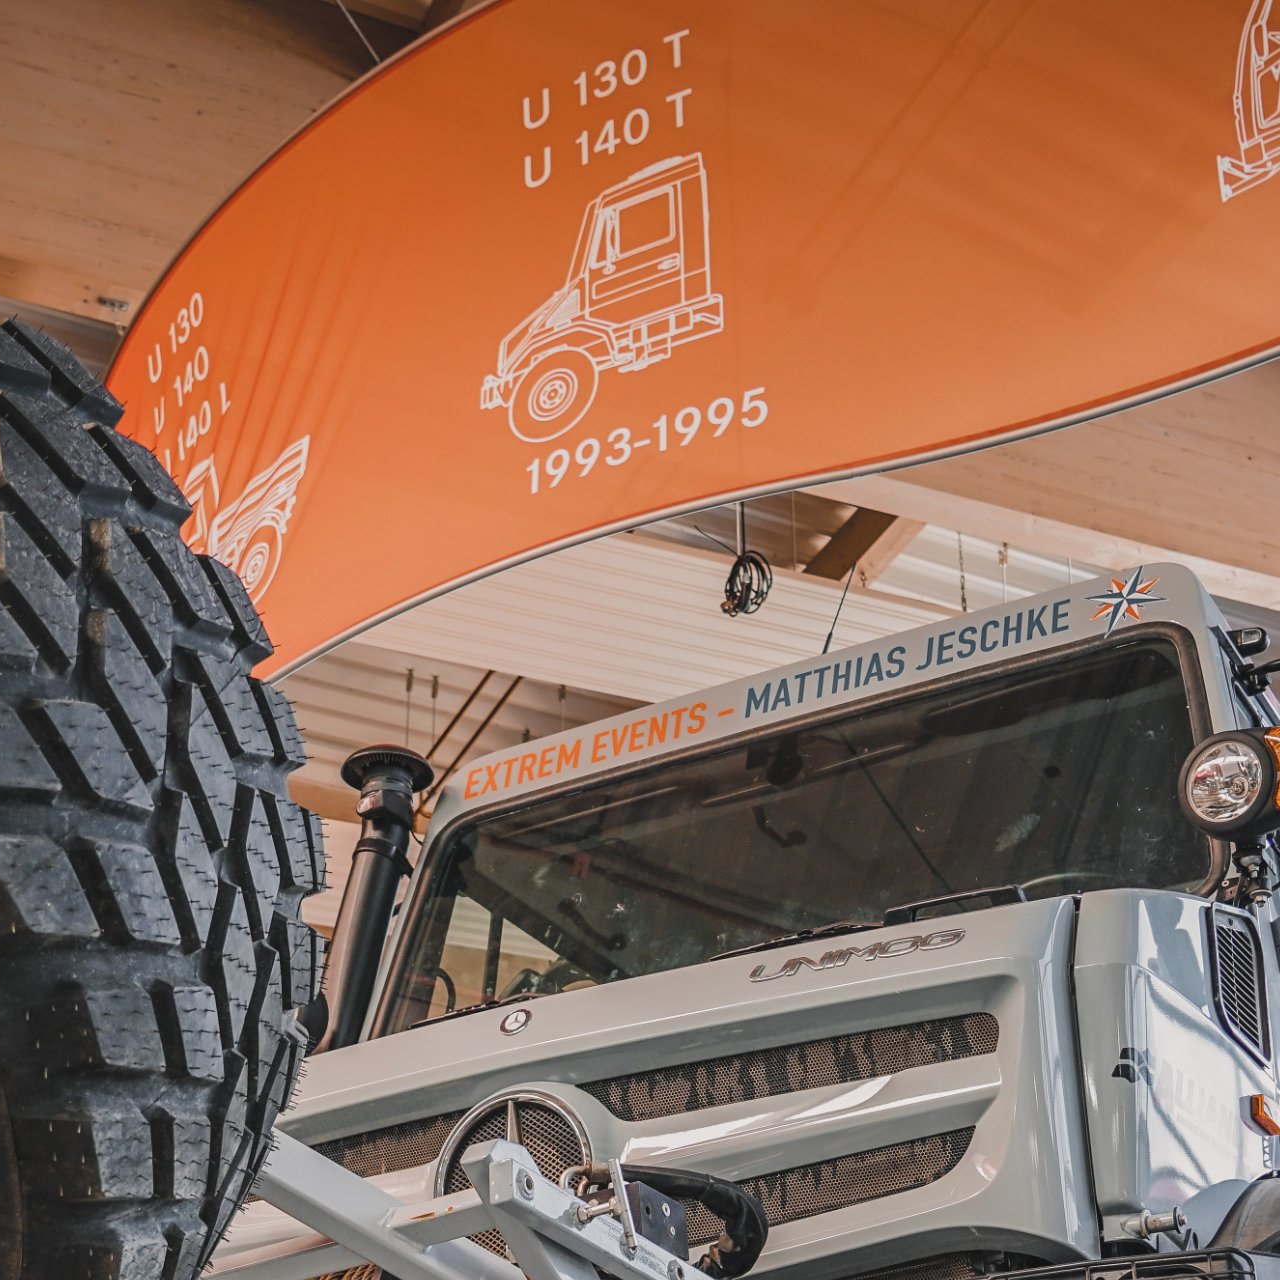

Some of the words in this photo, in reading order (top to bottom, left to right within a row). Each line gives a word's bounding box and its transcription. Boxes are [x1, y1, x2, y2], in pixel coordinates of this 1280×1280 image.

[522, 88, 551, 130] U
[573, 49, 647, 107] 130
[662, 29, 691, 69] T
[524, 147, 552, 188] U
[574, 107, 651, 166] 140
[665, 88, 693, 129] T
[147, 343, 163, 384] U
[169, 292, 204, 354] 130
[154, 396, 165, 435] U
[173, 345, 210, 408] 140
[177, 400, 212, 462] 140
[219, 382, 232, 416] L
[525, 386, 770, 495] 1993-1995
[463, 738, 583, 801] EXTREM
[591, 701, 708, 763] EVENTS
[744, 645, 907, 721] MATTHIAS
[916, 598, 1072, 672] JESCHKE
[749, 928, 967, 983] UNIMOG
